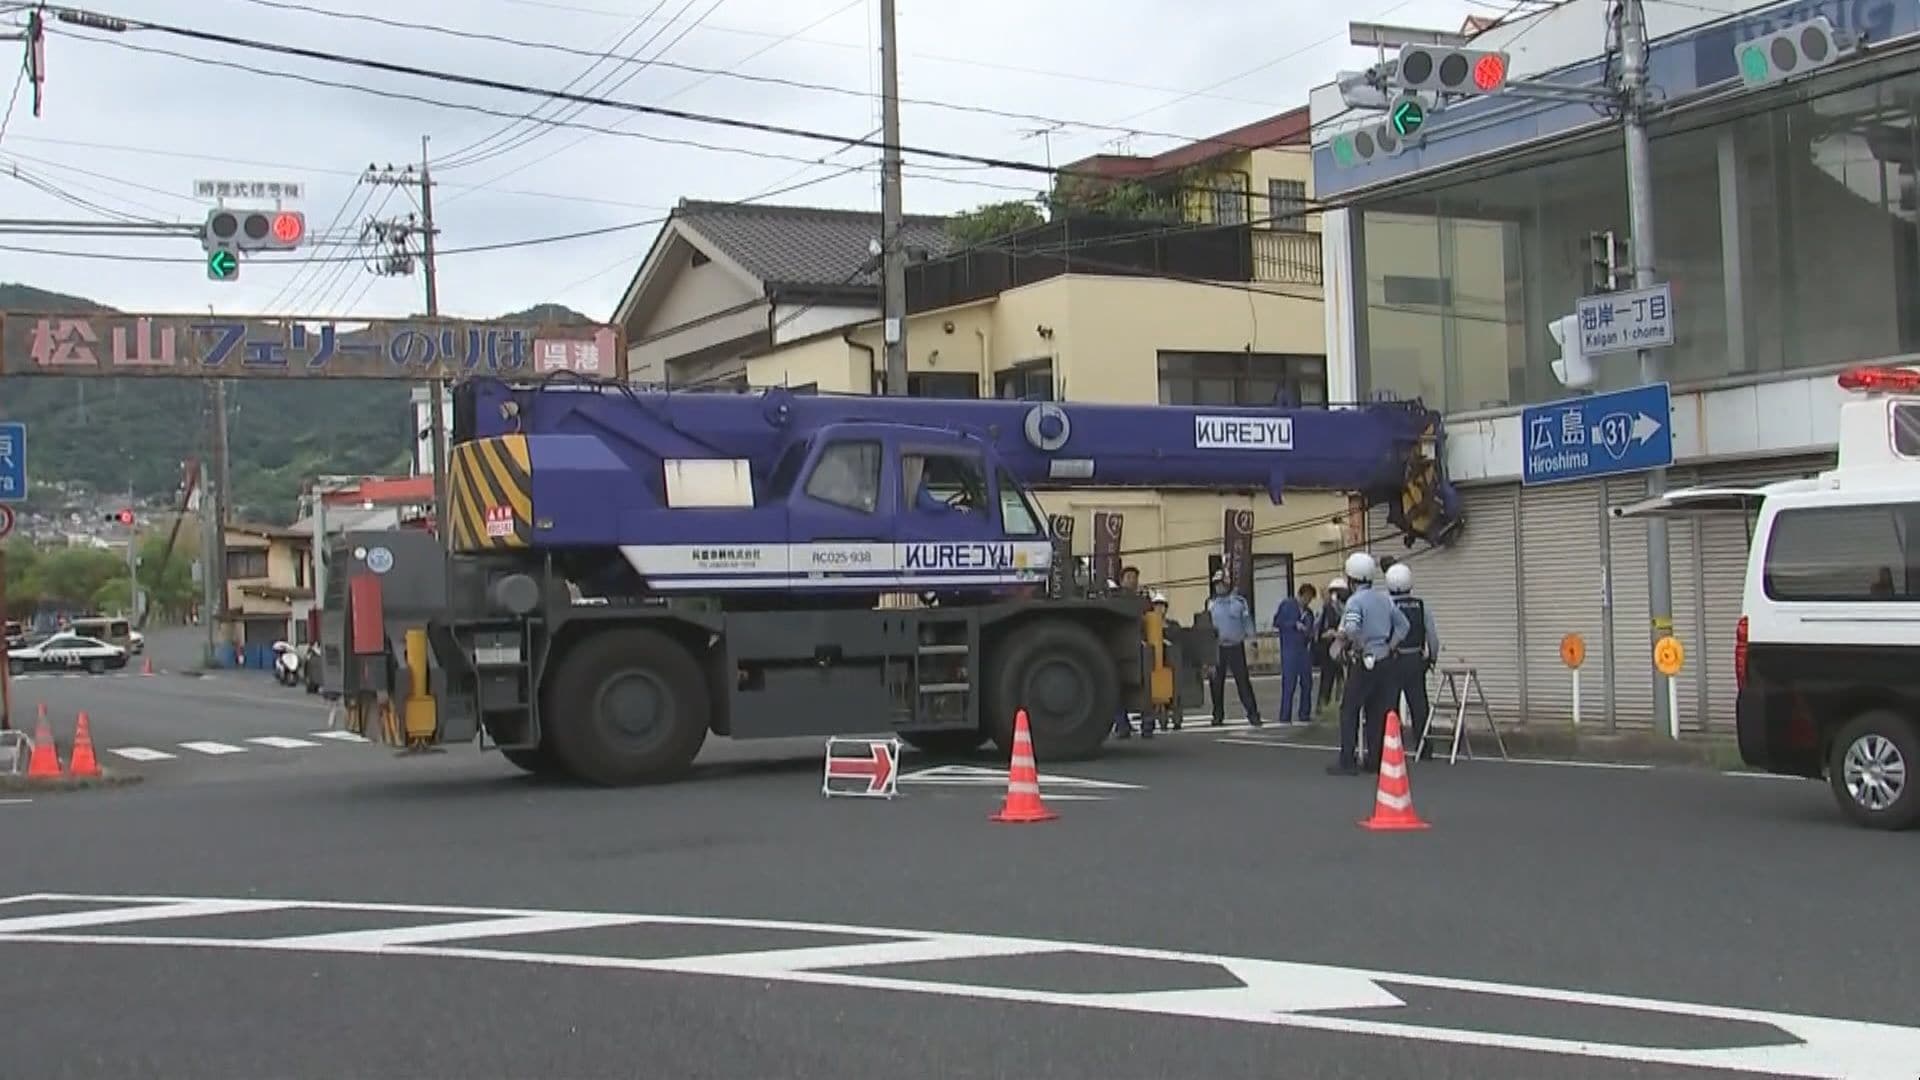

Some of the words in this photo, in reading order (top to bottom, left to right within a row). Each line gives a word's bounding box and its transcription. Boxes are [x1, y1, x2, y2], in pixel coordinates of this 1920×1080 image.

[1581, 295, 1666, 330] 海岸一丁目
[1530, 405, 1585, 450] 広島
[1606, 418, 1626, 446] 31
[1528, 451, 1589, 475] Hiroshima
